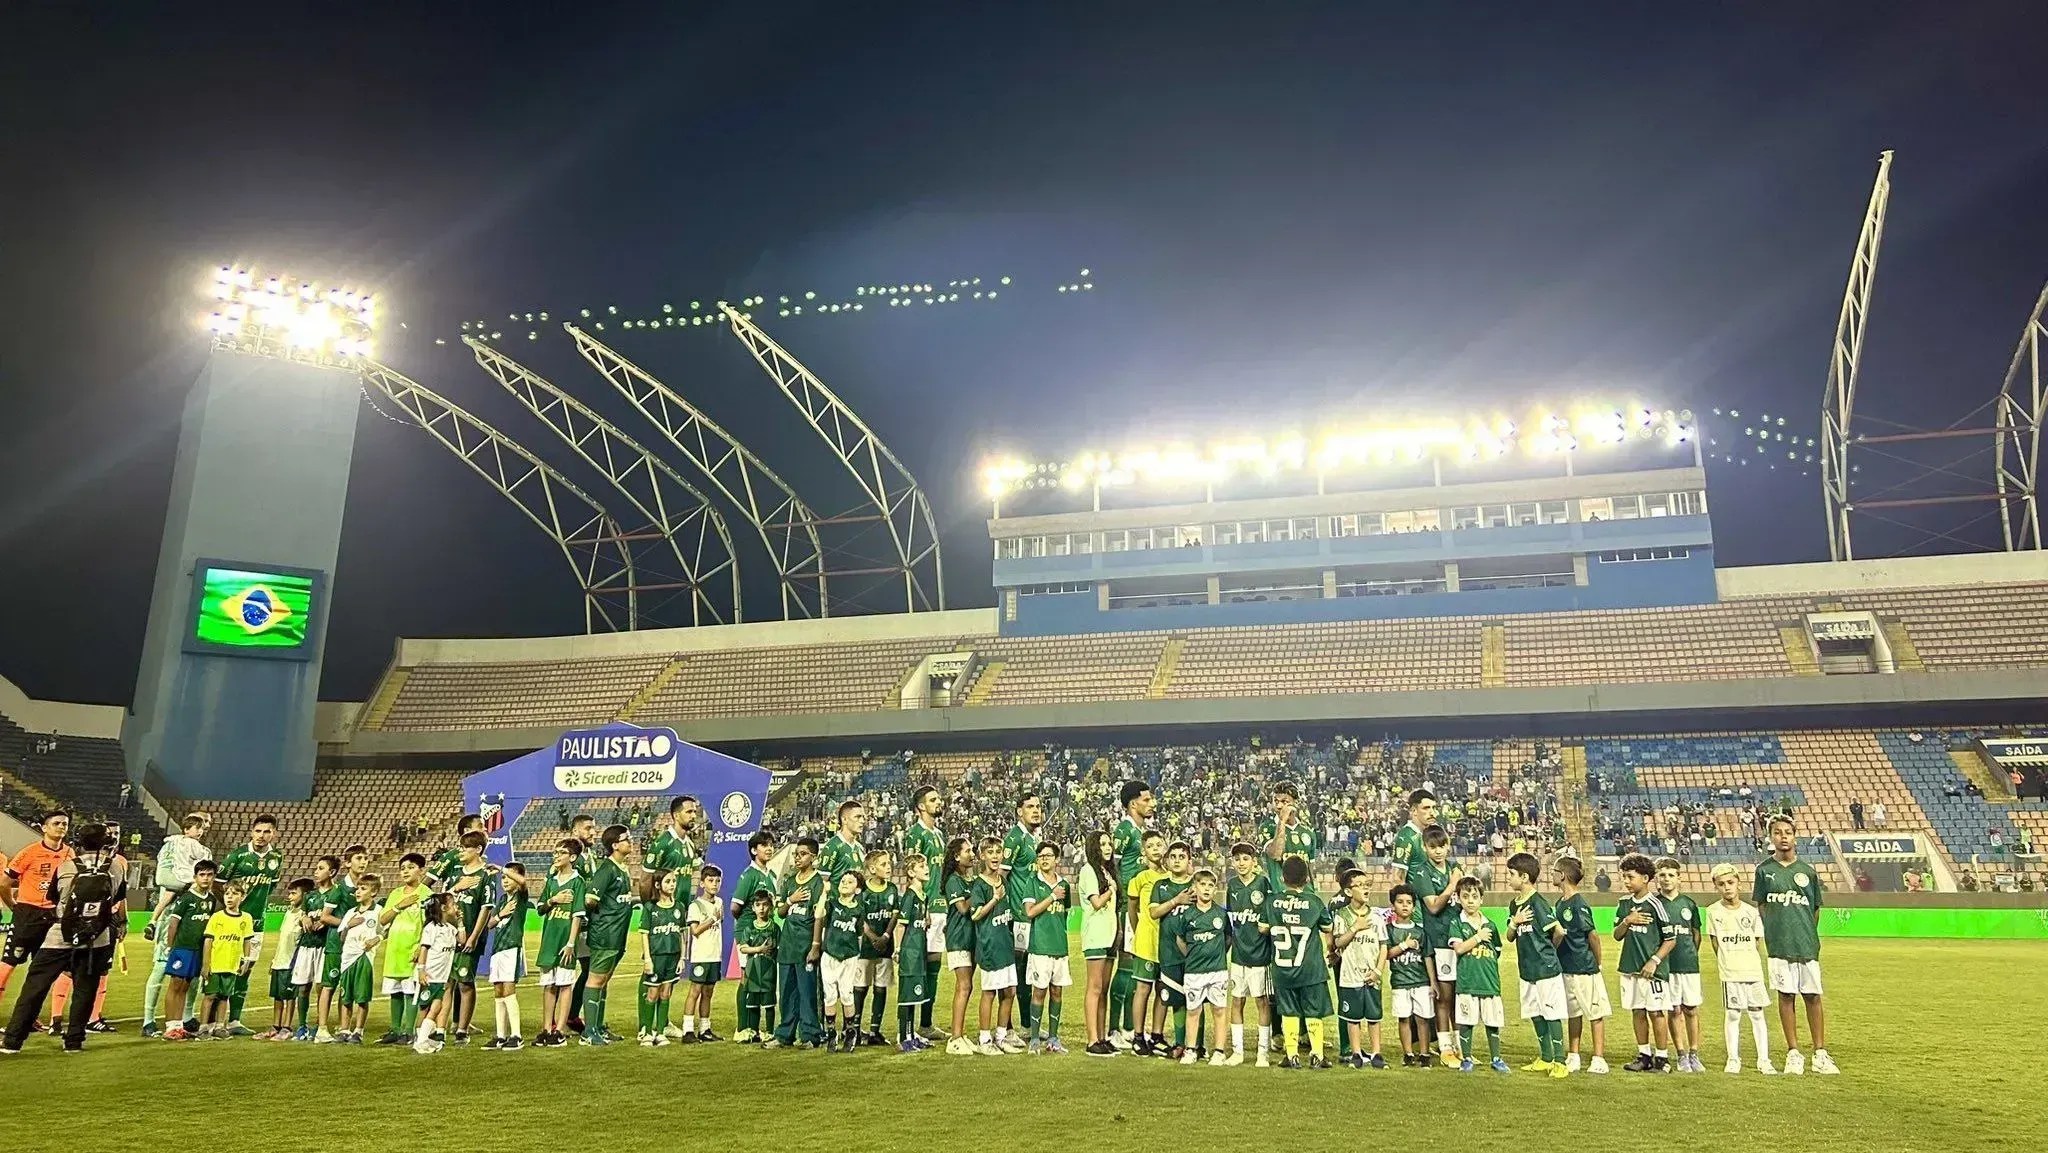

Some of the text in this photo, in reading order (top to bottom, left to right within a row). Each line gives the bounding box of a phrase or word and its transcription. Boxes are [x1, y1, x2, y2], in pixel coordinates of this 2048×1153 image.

[2005, 744, 2044, 756] SAÍDA
[582, 771, 663, 785] Sicredi 2024
[1853, 838, 1903, 853] SAÍDA
[1273, 897, 1309, 912] crefisa
[1766, 890, 1809, 907] crefisa
[548, 906, 571, 921] fisa
[1270, 925, 1312, 967] 27
[1722, 934, 1751, 945] crefisa
[1650, 980, 1663, 994] 10
